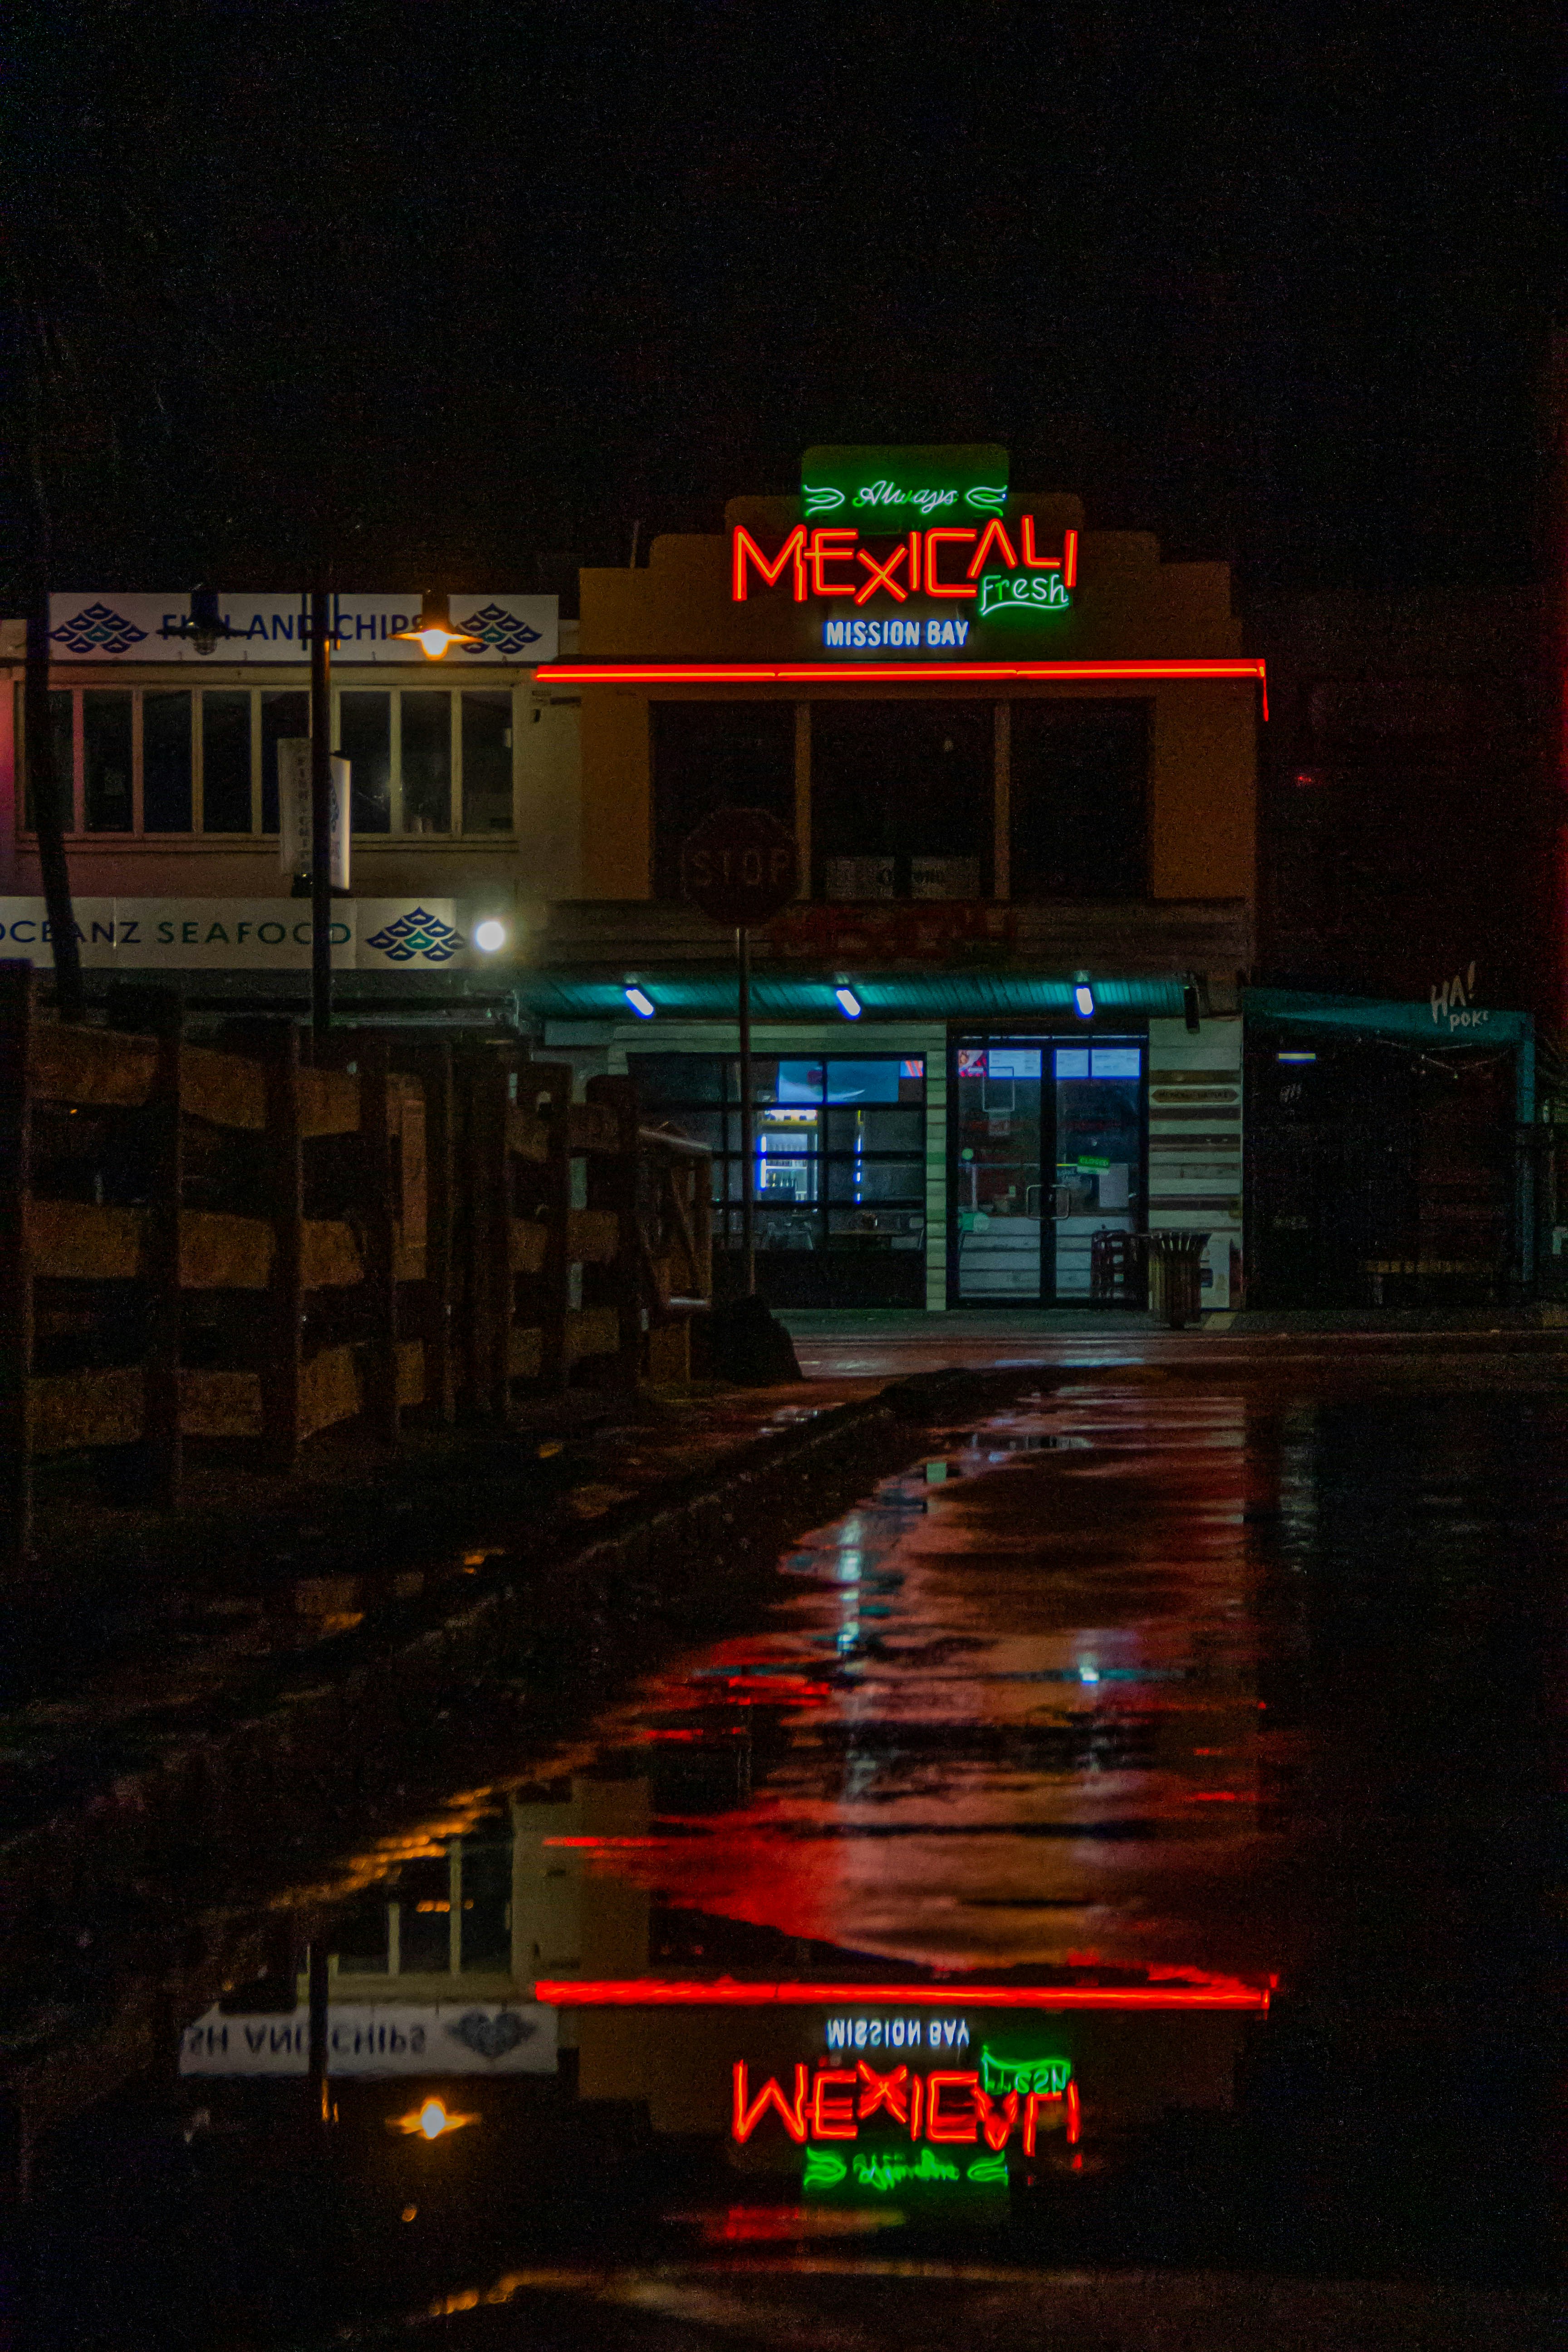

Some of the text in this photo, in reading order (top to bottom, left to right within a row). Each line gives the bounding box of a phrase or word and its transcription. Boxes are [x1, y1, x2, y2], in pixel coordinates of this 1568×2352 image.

[853, 480, 959, 514] Always
[732, 514, 1078, 607] MEXICALI
[980, 573, 1070, 611] Fresh
[163, 614, 230, 640] FI
[825, 620, 969, 647] MISSION BAY
[692, 848, 789, 887] STOP
[0, 920, 352, 944] CENZ SEAFOOD
[1430, 960, 1476, 1024] HA!
